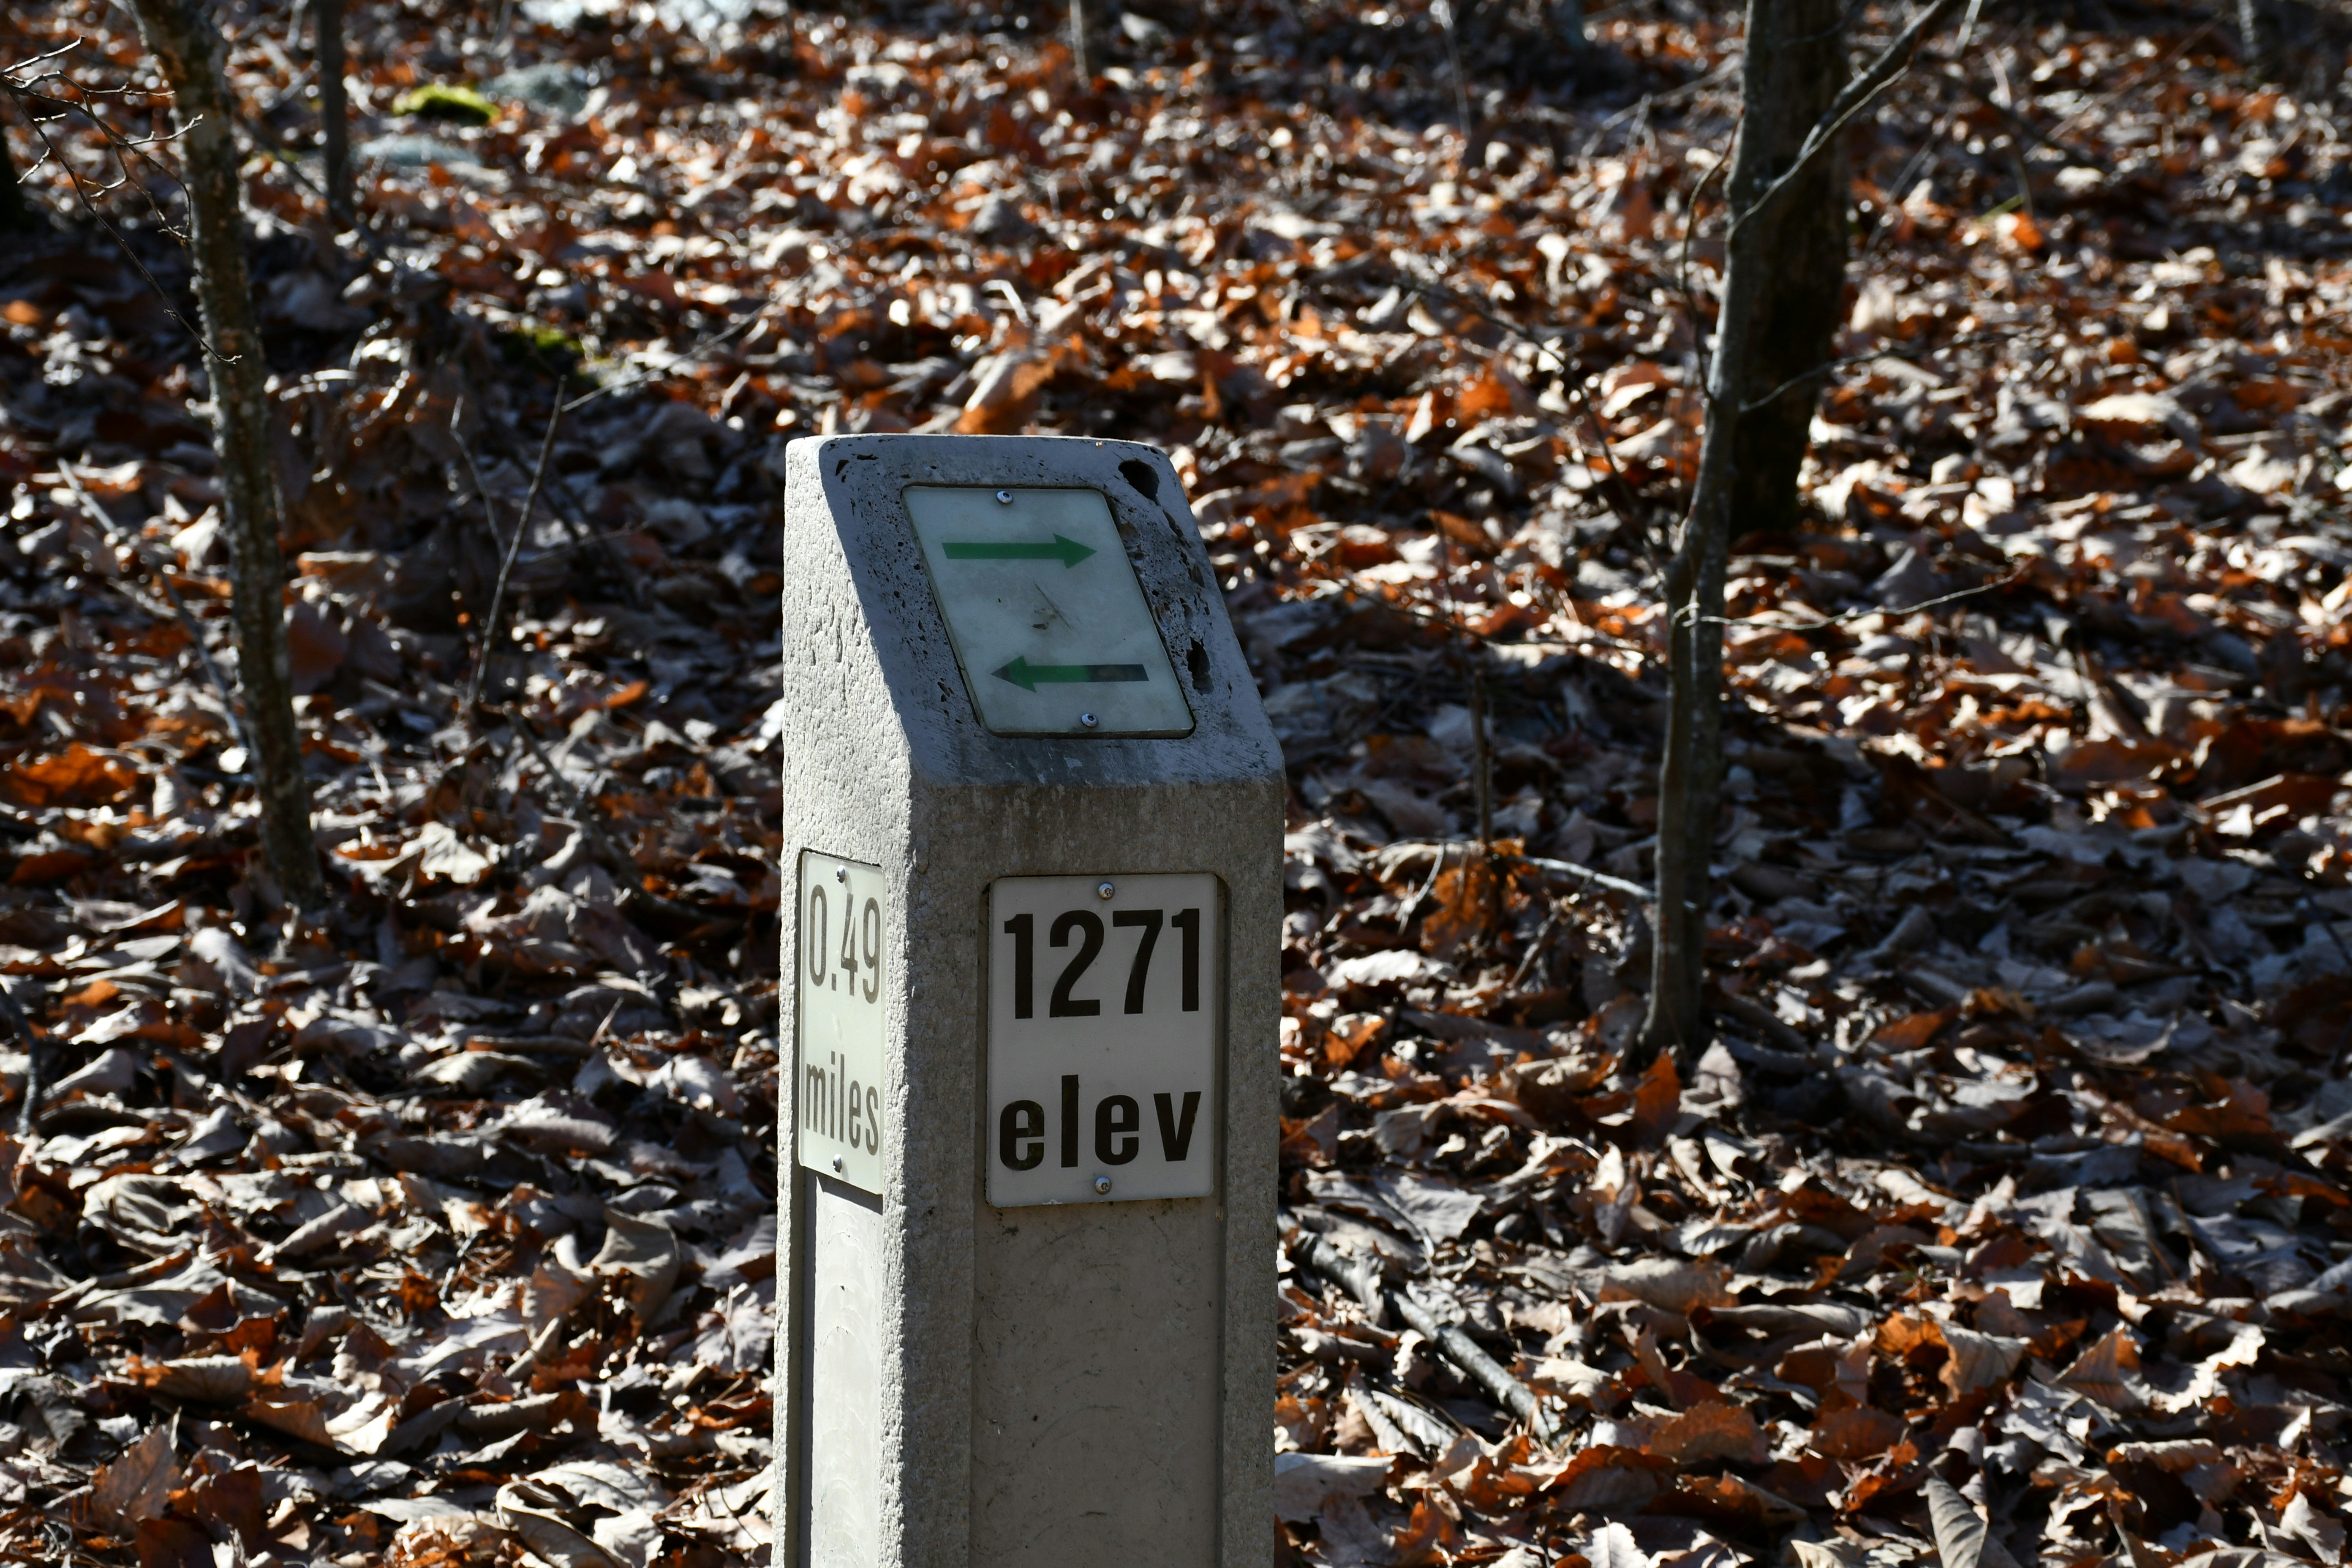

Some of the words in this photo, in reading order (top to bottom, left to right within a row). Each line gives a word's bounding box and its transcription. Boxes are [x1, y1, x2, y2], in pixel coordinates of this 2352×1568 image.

[808, 885, 881, 1004] 0.49
[1004, 908, 1200, 1019] 1271
[805, 1051, 879, 1156] miles
[999, 1074, 1201, 1171] elev
